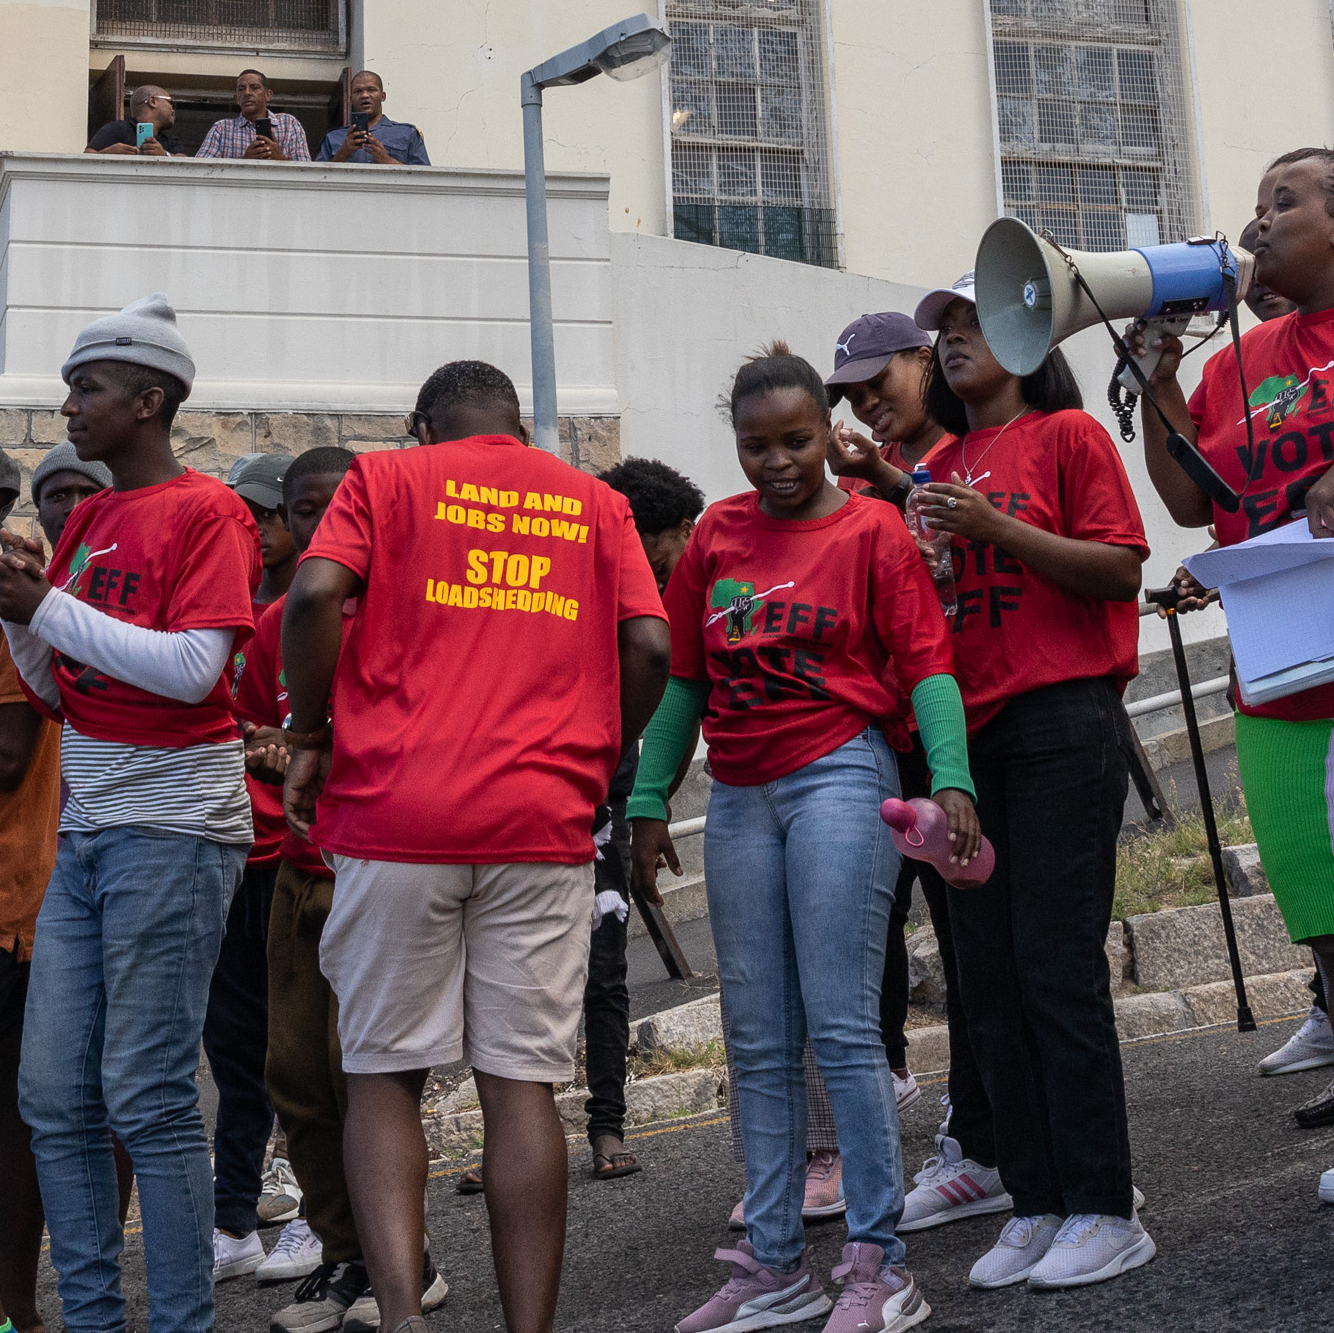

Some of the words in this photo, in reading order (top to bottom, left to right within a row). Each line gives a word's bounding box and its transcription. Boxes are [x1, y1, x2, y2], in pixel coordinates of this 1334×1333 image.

[445, 479, 520, 509] LAND
[523, 491, 583, 517] AND
[986, 491, 1031, 518] FF
[434, 502, 506, 533] JOBS
[511, 514, 590, 544] NOW!
[86, 567, 141, 606] EFF
[466, 548, 551, 589] STOP
[425, 577, 579, 622] LOADSHEDDING
[952, 585, 1023, 634] FF
[763, 601, 838, 640] EFF
